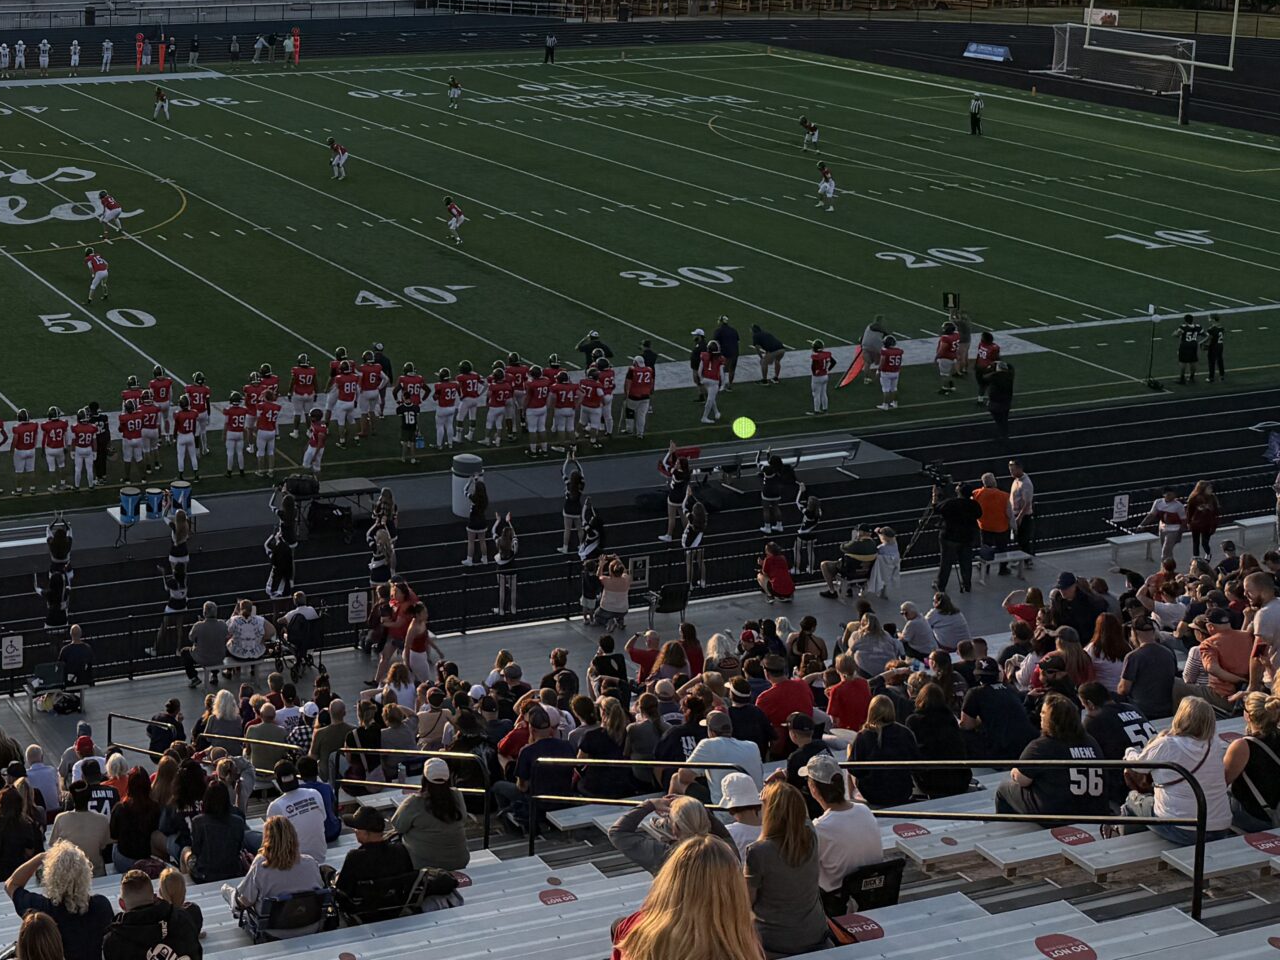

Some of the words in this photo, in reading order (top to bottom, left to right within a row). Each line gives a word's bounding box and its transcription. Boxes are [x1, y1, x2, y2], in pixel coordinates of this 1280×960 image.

[1106, 229, 1215, 249] 10
[875, 248, 972, 269] 20
[621, 266, 734, 288] 30
[355, 286, 458, 309] 40
[946, 293, 954, 307] 1
[38, 308, 157, 333] 50
[889, 355, 901, 366] 56
[299, 374, 313, 385] 50
[369, 373, 376, 383] 6
[636, 372, 651, 383] 72
[159, 388, 166, 398] 8
[192, 392, 204, 404] 31
[232, 415, 245, 427] 39
[403, 411, 415, 424] 16
[127, 420, 141, 432] 60
[183, 418, 194, 431] 41
[23, 431, 34, 443] 61
[49, 429, 62, 441] 43
[78, 433, 92, 445] 28
[1069, 746, 1096, 759] MENE
[1069, 768, 1104, 797] 56
[862, 923, 879, 931] DO
[1050, 948, 1072, 958] NOT
[1071, 944, 1089, 952] DO
